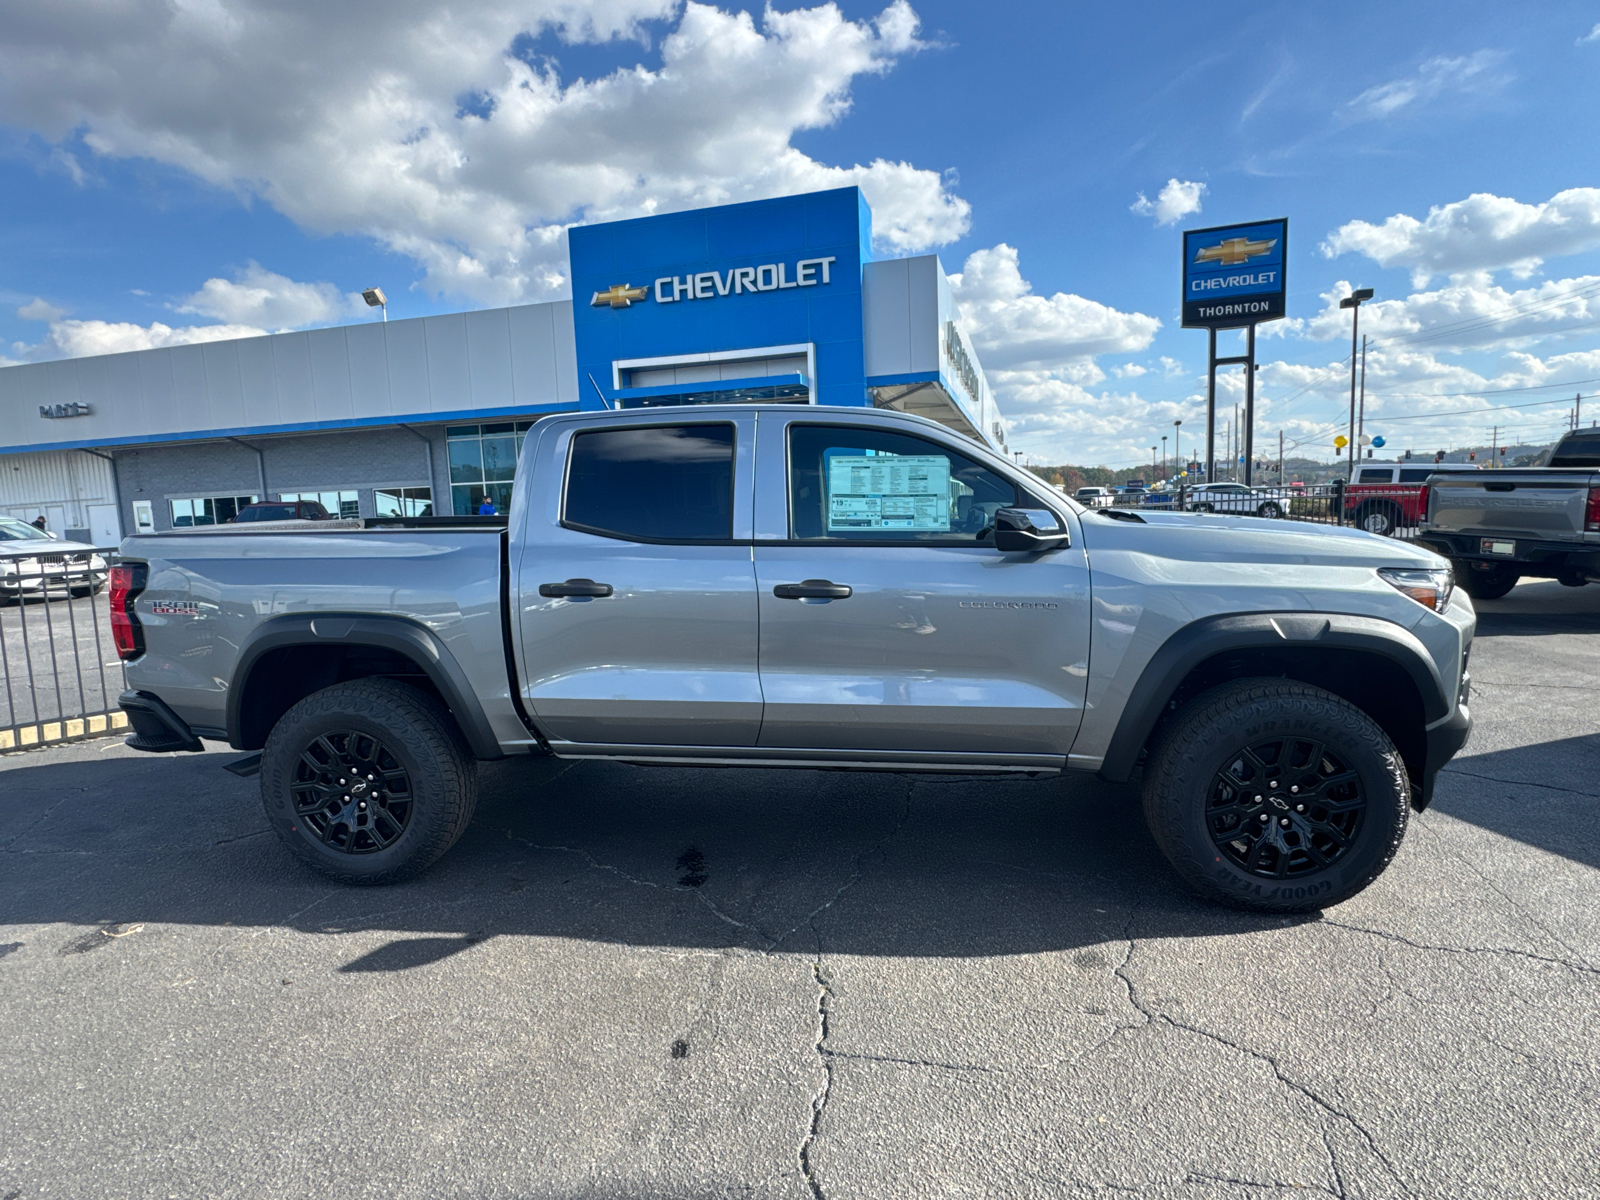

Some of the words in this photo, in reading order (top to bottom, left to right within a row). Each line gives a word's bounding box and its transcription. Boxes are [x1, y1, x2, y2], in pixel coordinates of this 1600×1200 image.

[655, 256, 836, 303] CHEVROLET
[1192, 272, 1277, 292] CHEVROLET
[1198, 301, 1269, 317] THORNTON
[39, 402, 83, 418] PARTS
[1439, 497, 1569, 509] CHEVROLET
[144, 600, 199, 608] TRAIL
[959, 601, 1058, 609] COLORADO
[1246, 719, 1360, 750] WRANGLER
